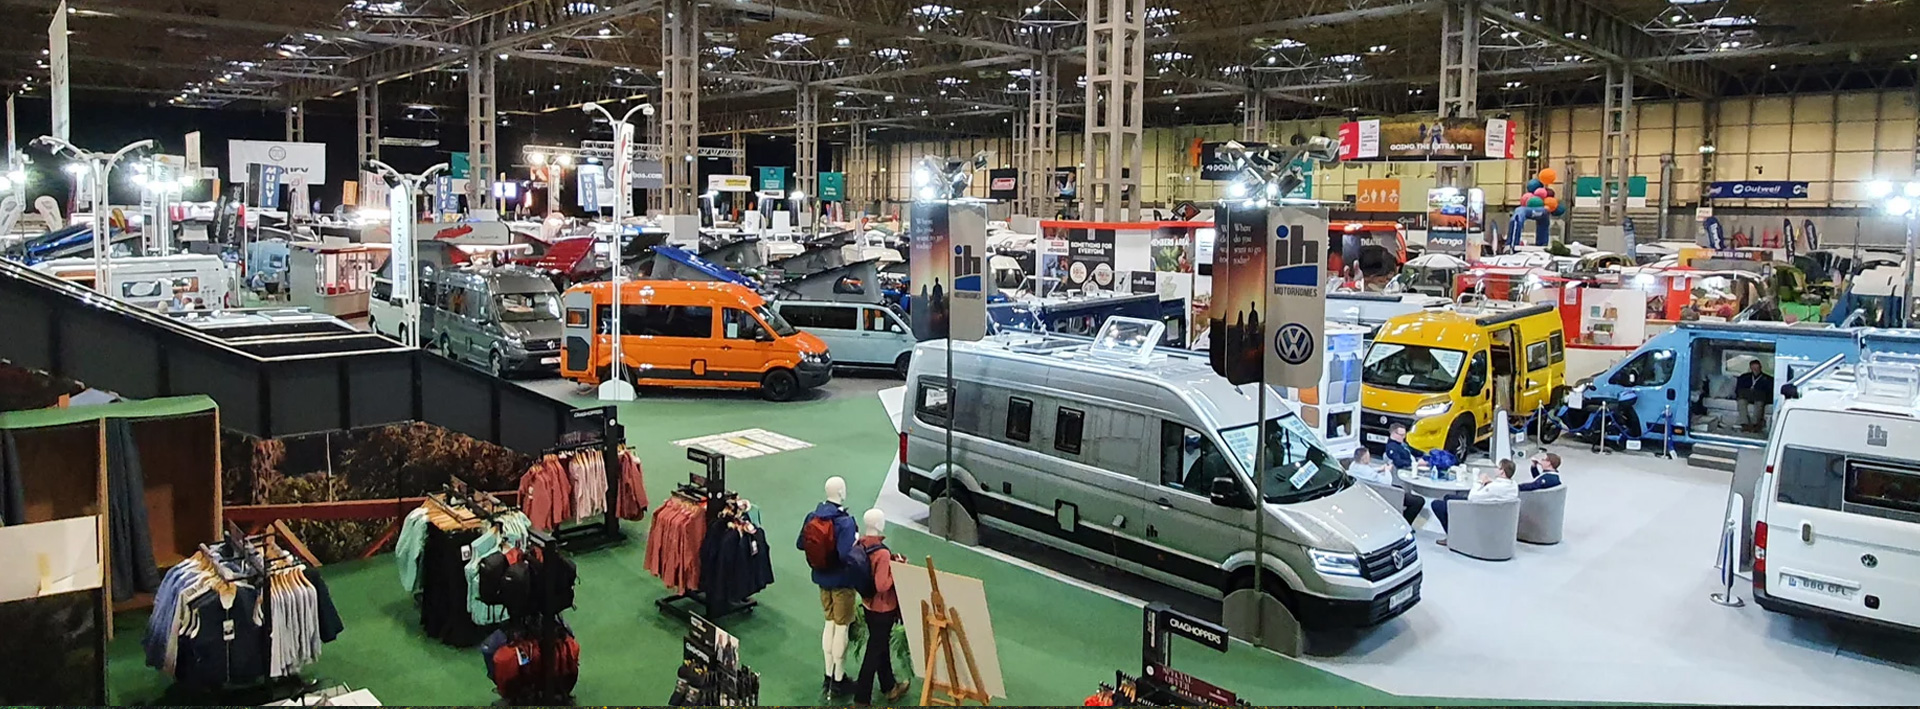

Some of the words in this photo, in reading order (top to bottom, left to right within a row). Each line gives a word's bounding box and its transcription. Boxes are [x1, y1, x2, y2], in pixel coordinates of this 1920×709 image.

[265, 166, 277, 206] MURVI
[1744, 185, 1781, 194] Outwell
[1233, 223, 1251, 232] Where
[1233, 235, 1241, 243] do
[1071, 242, 1101, 251] SOMETHING
[1102, 243, 1113, 252] FOR
[1275, 224, 1319, 267] ih
[1078, 248, 1105, 256] EVERYONE
[1274, 286, 1318, 297] MOTORHOMES
[1170, 617, 1222, 646] CRAGHOPPERS
